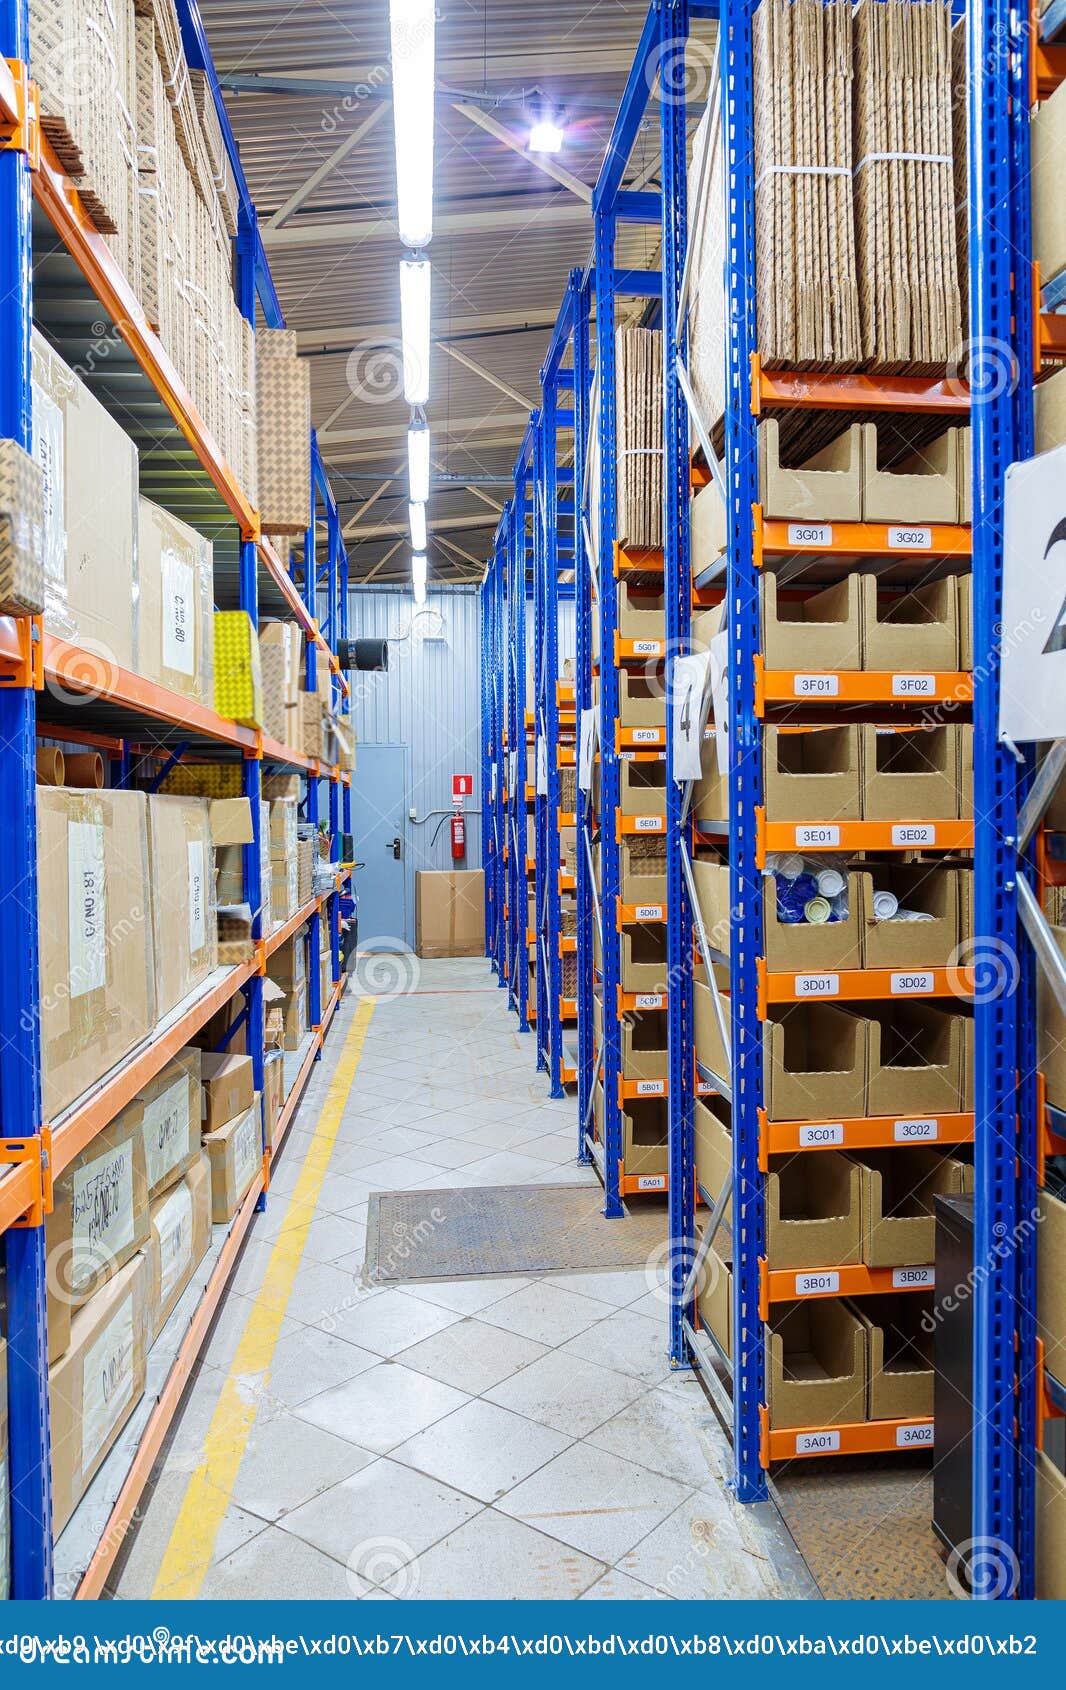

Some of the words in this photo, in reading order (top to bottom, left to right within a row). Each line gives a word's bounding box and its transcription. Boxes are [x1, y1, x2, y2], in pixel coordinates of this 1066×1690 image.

[795, 529, 824, 541] 3G01
[896, 532, 924, 544] 3G02
[637, 643, 656, 651] 5G01
[802, 679, 830, 691] 3F01
[900, 679, 928, 691] 3F02
[680, 684, 692, 742] 4
[637, 732, 655, 740] 5F01
[639, 819, 657, 827] 5E01
[803, 830, 831, 842] 3E01
[899, 829, 928, 841] 3E02
[639, 909, 658, 917] 5D01
[802, 979, 831, 991] 3D01
[899, 977, 927, 989] 3D02
[639, 997, 658, 1005] 5C01
[642, 1083, 660, 1091] 5B01
[807, 1129, 835, 1141] 3C01
[902, 1124, 931, 1136] 3C02
[642, 1178, 660, 1187] 5A01
[900, 1270, 928, 1282] 3B02
[803, 1277, 831, 1290] 3B01
[903, 1429, 932, 1441] 3A02
[804, 1436, 832, 1449] 3A01
